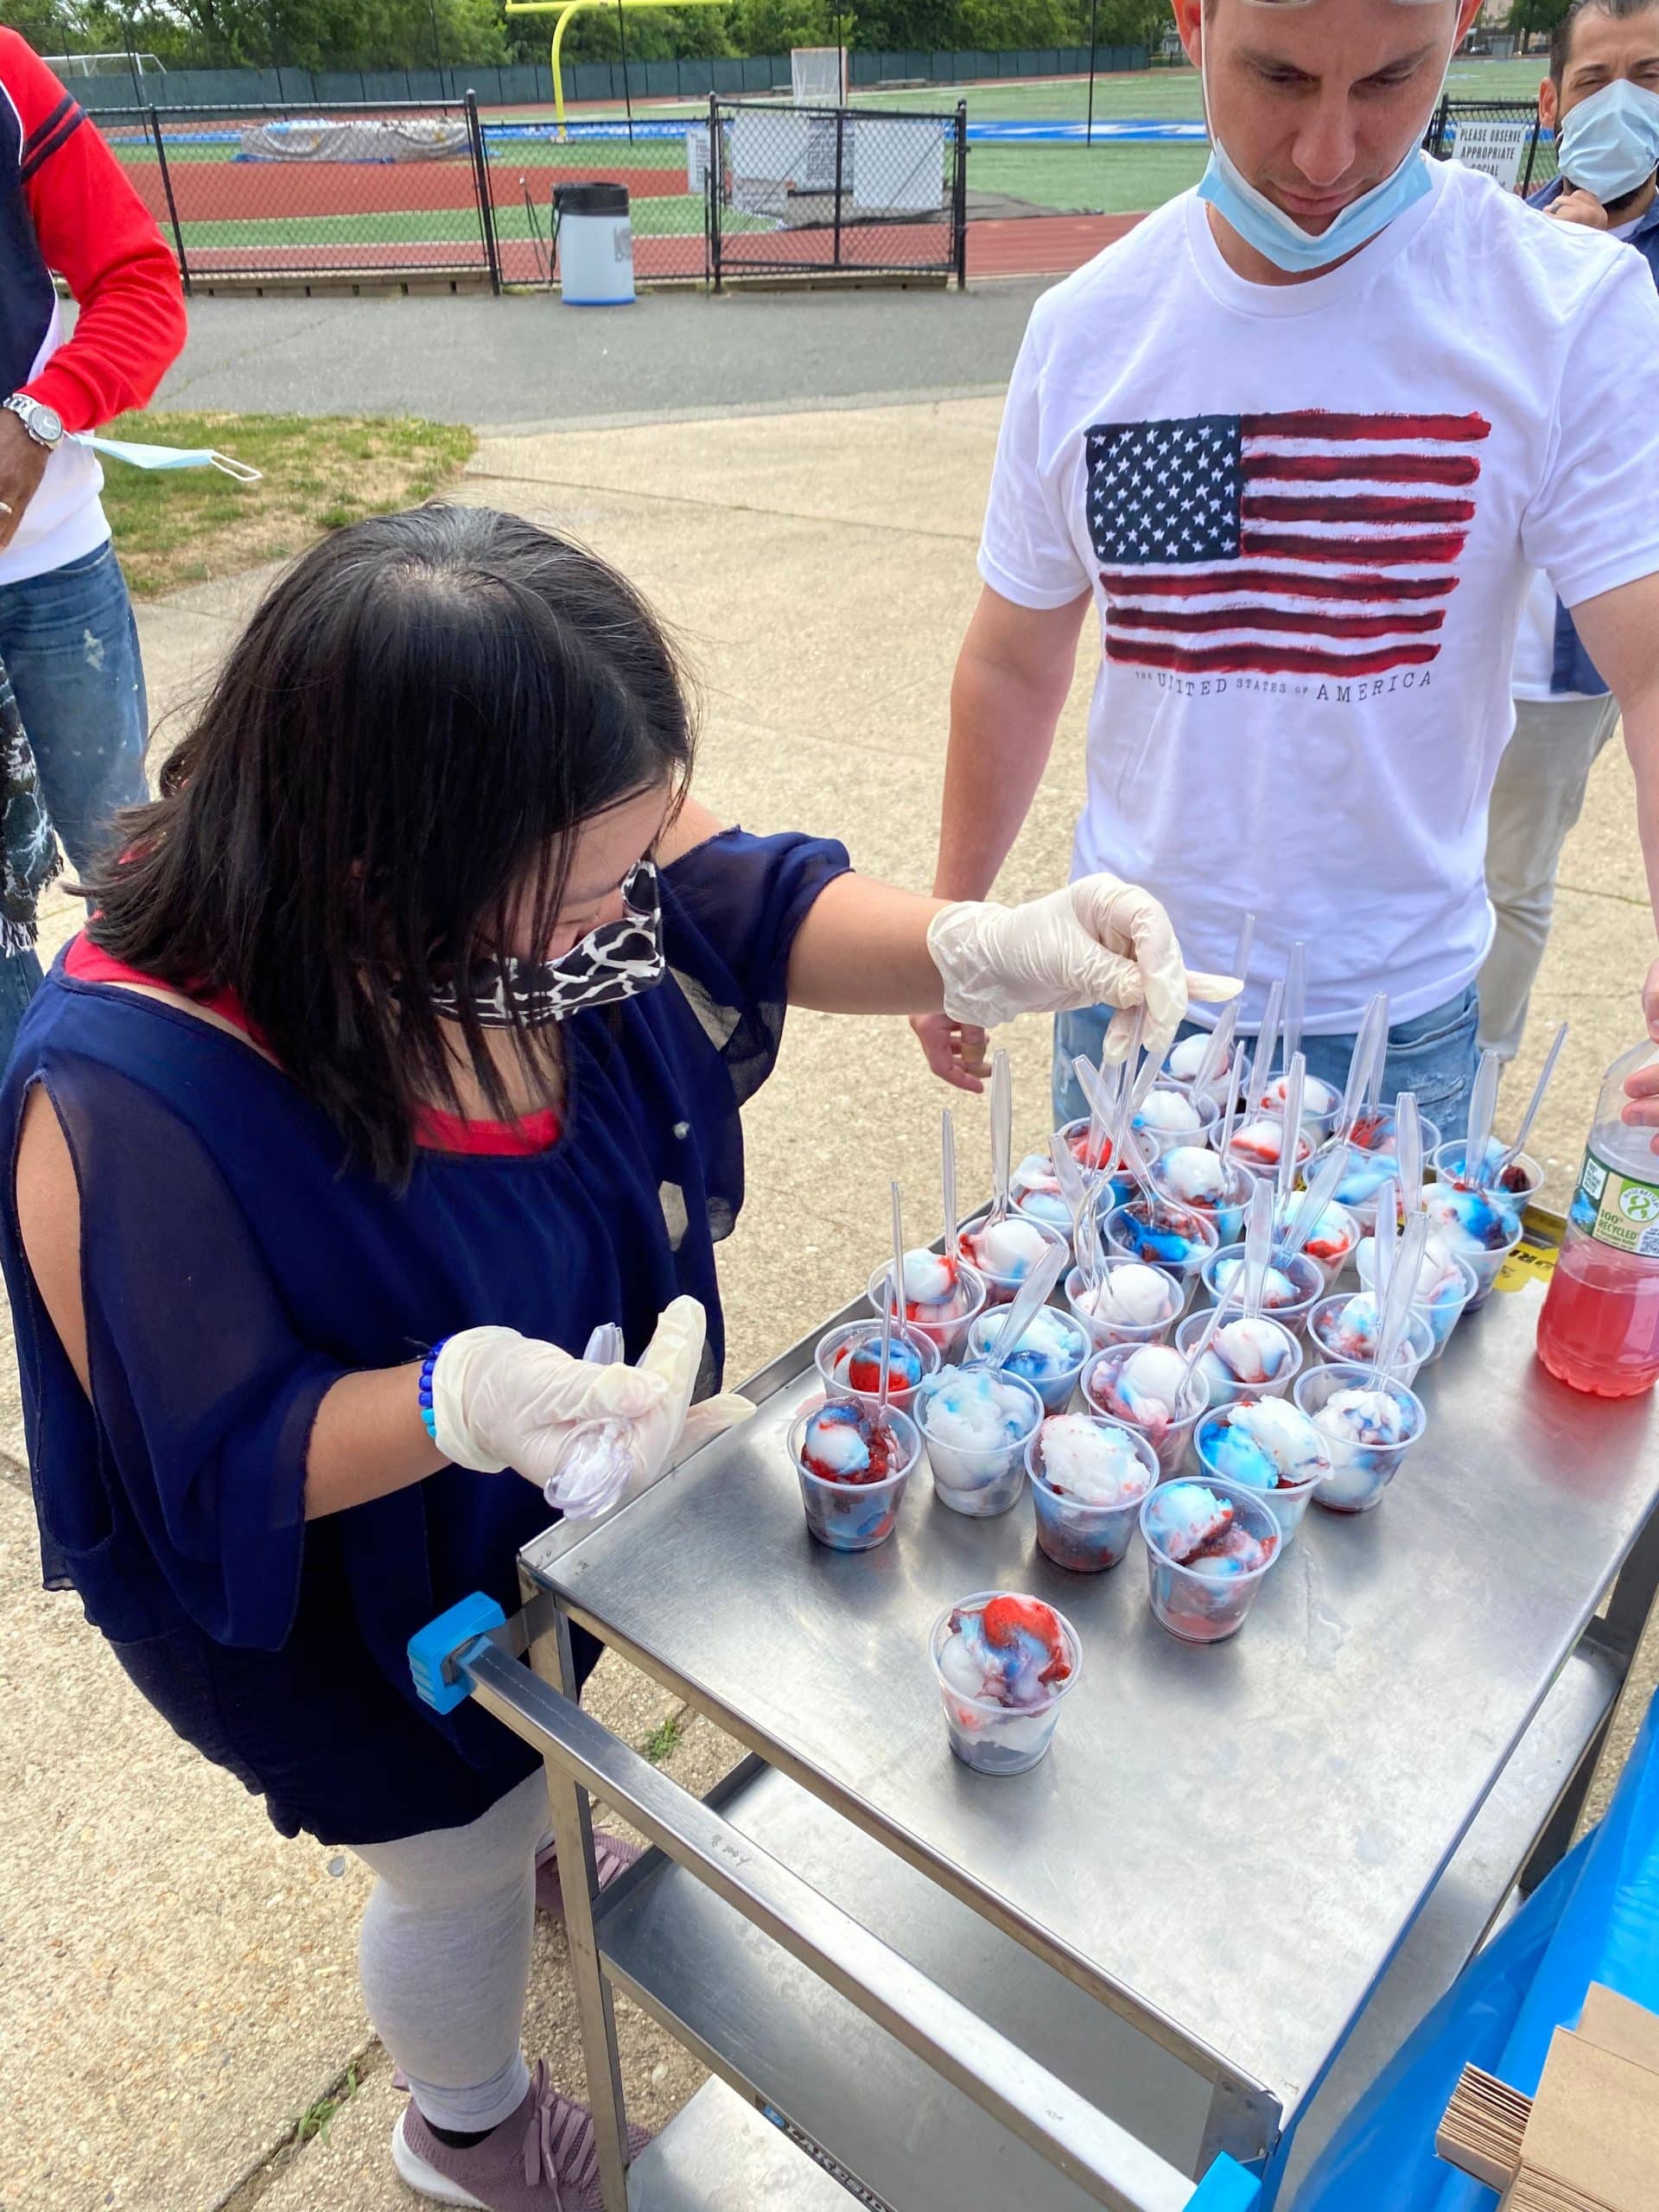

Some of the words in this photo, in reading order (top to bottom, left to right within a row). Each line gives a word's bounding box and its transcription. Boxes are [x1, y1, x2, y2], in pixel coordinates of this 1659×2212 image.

[1459, 128, 1487, 143] PLEASE
[1490, 129, 1522, 143] OBSERVE
[1460, 146, 1516, 160] APPROPRIATE
[1236, 677, 1287, 694] STATES
[1294, 686, 1308, 695] OF
[1316, 671, 1432, 702] AMERICA
